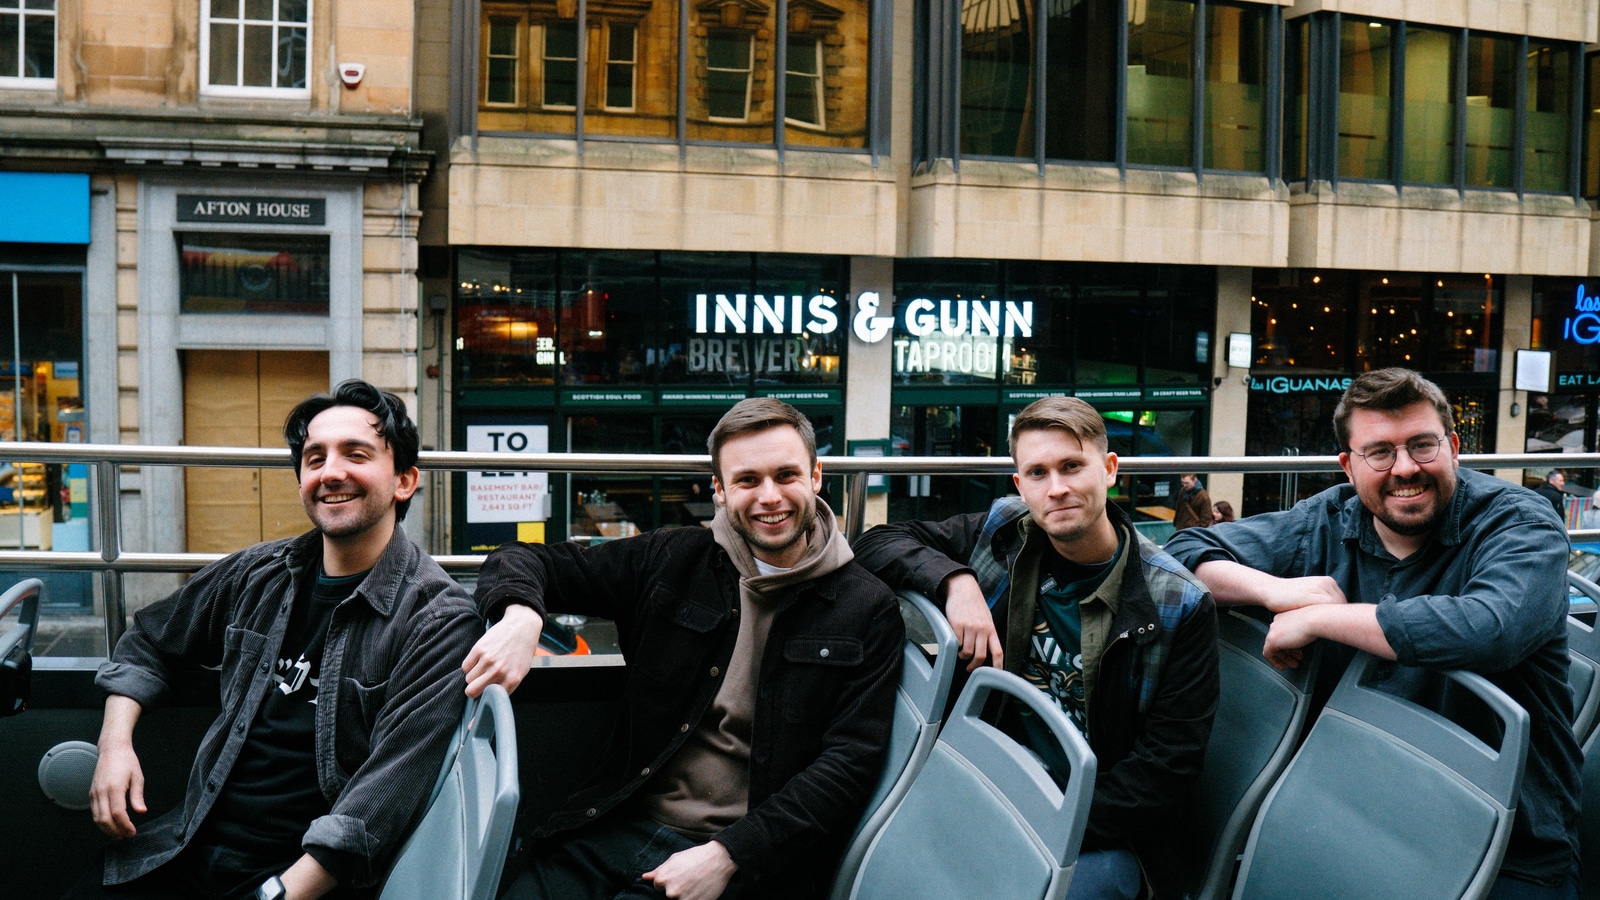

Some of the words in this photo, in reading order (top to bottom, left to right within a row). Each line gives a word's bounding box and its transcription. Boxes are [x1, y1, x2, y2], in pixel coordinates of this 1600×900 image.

[194, 201, 250, 216] AFTON
[256, 203, 310, 218] HOUSE
[695, 294, 838, 334] INNIS
[853, 291, 895, 343] &
[905, 298, 1033, 337] GUNN
[1266, 376, 1354, 393] IGUANAS
[1559, 375, 1584, 386] EAT
[487, 432, 528, 452] TO
[470, 484, 518, 492] BASEMENT
[477, 493, 536, 501] RESTAURANT
